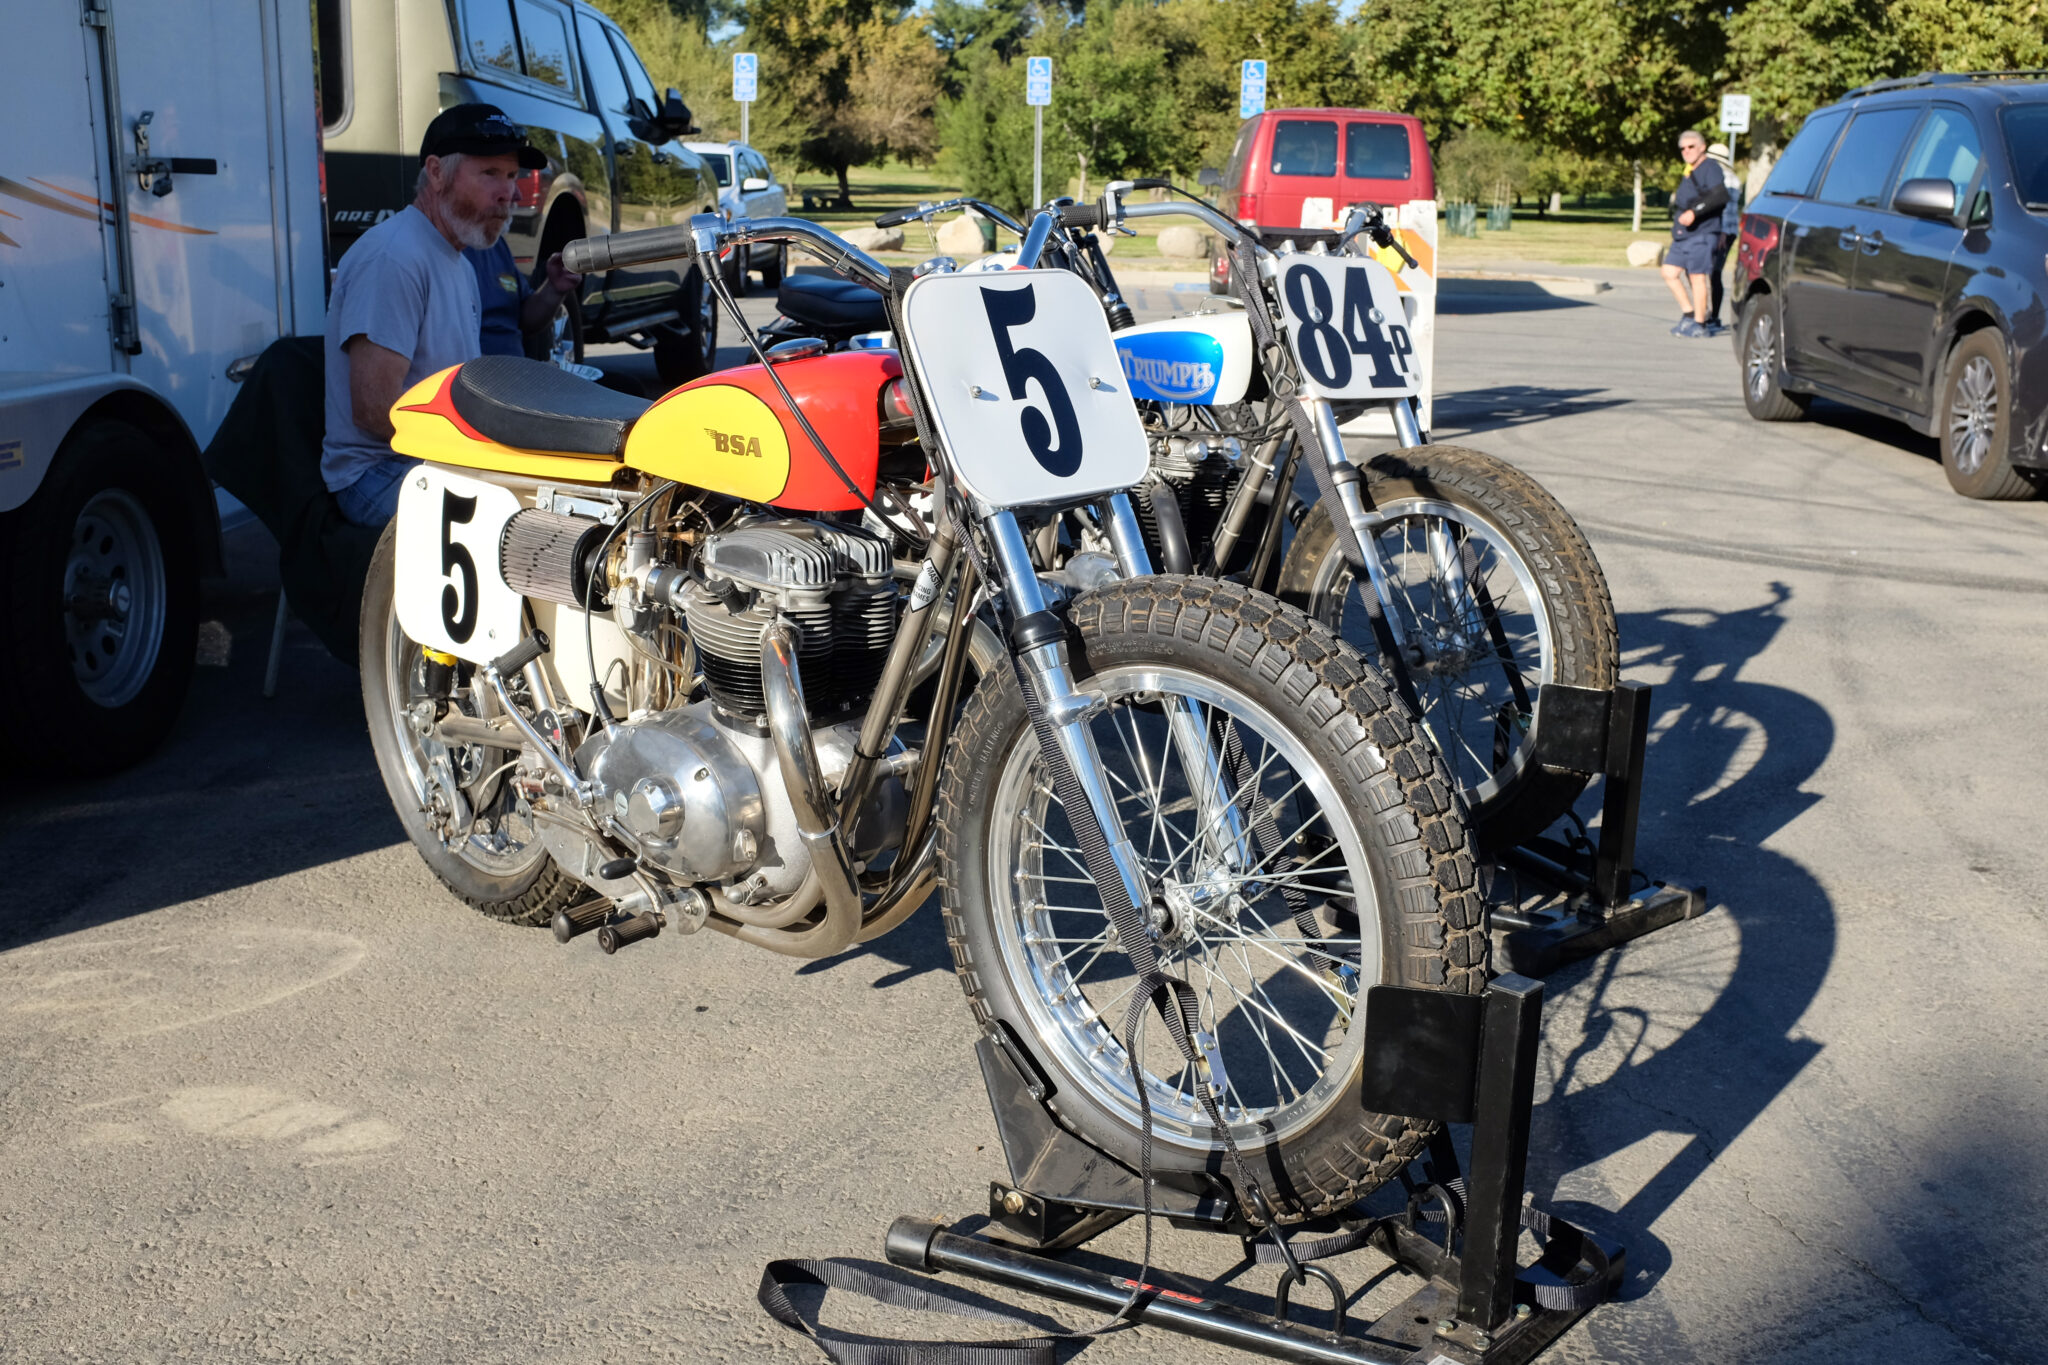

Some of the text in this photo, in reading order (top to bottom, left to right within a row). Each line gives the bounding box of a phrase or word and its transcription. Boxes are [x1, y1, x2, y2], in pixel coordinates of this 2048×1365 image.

[979, 282, 1083, 478] 5
[1119, 347, 1215, 390] TRIUMPH
[715, 432, 762, 458] BSA
[441, 486, 479, 644] 5
[927, 566, 942, 590] MASTE
